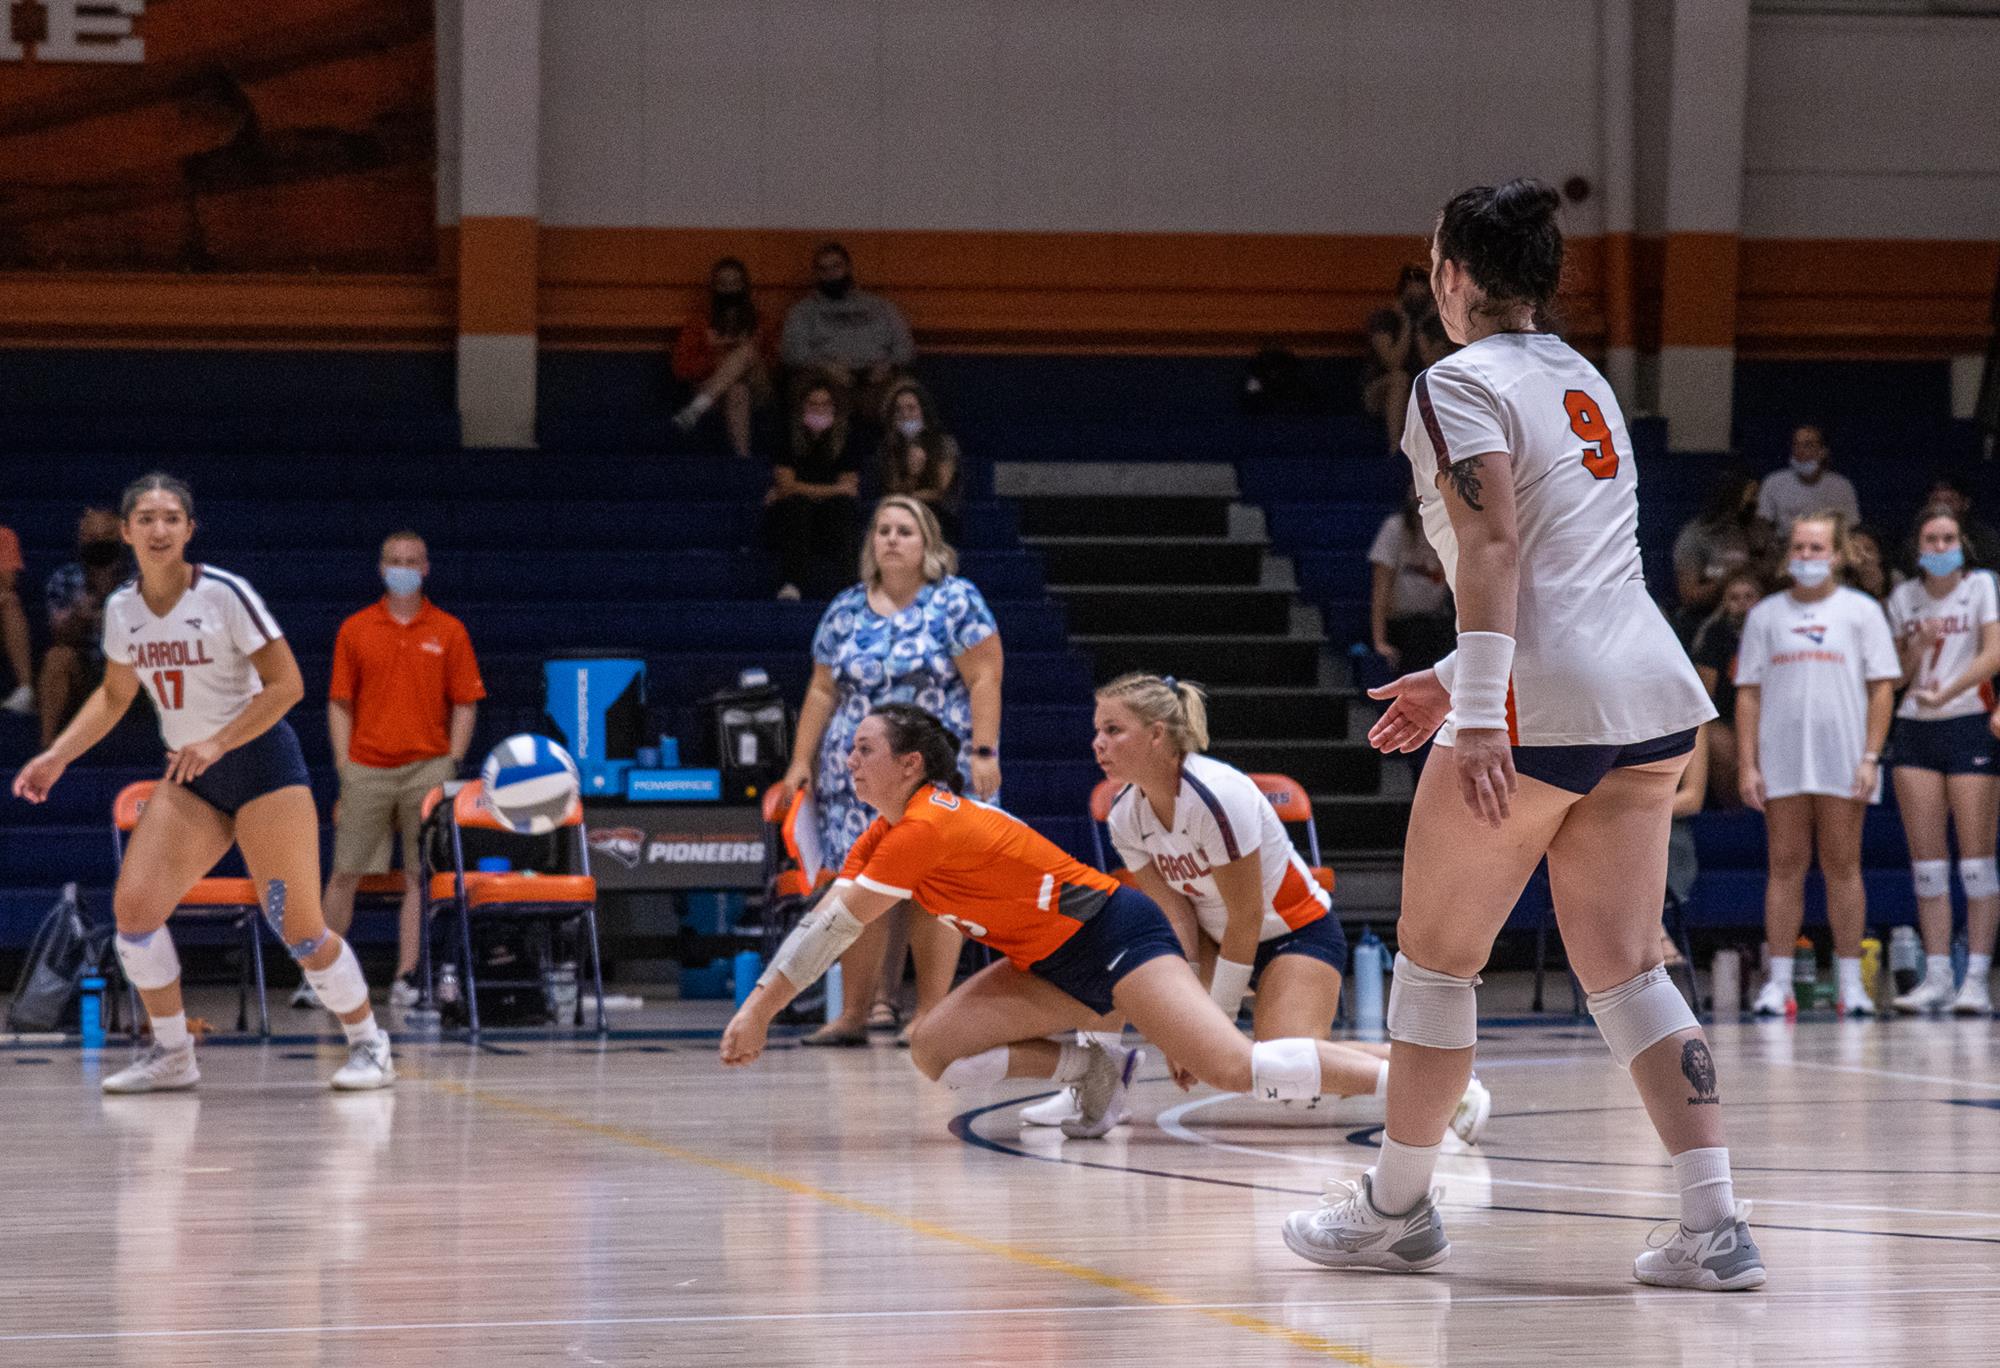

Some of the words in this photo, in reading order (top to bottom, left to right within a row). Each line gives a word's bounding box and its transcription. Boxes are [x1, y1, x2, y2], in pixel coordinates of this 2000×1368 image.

[1563, 389, 1619, 480] 9
[152, 669, 184, 710] 17
[647, 842, 765, 863] PIONEERS
